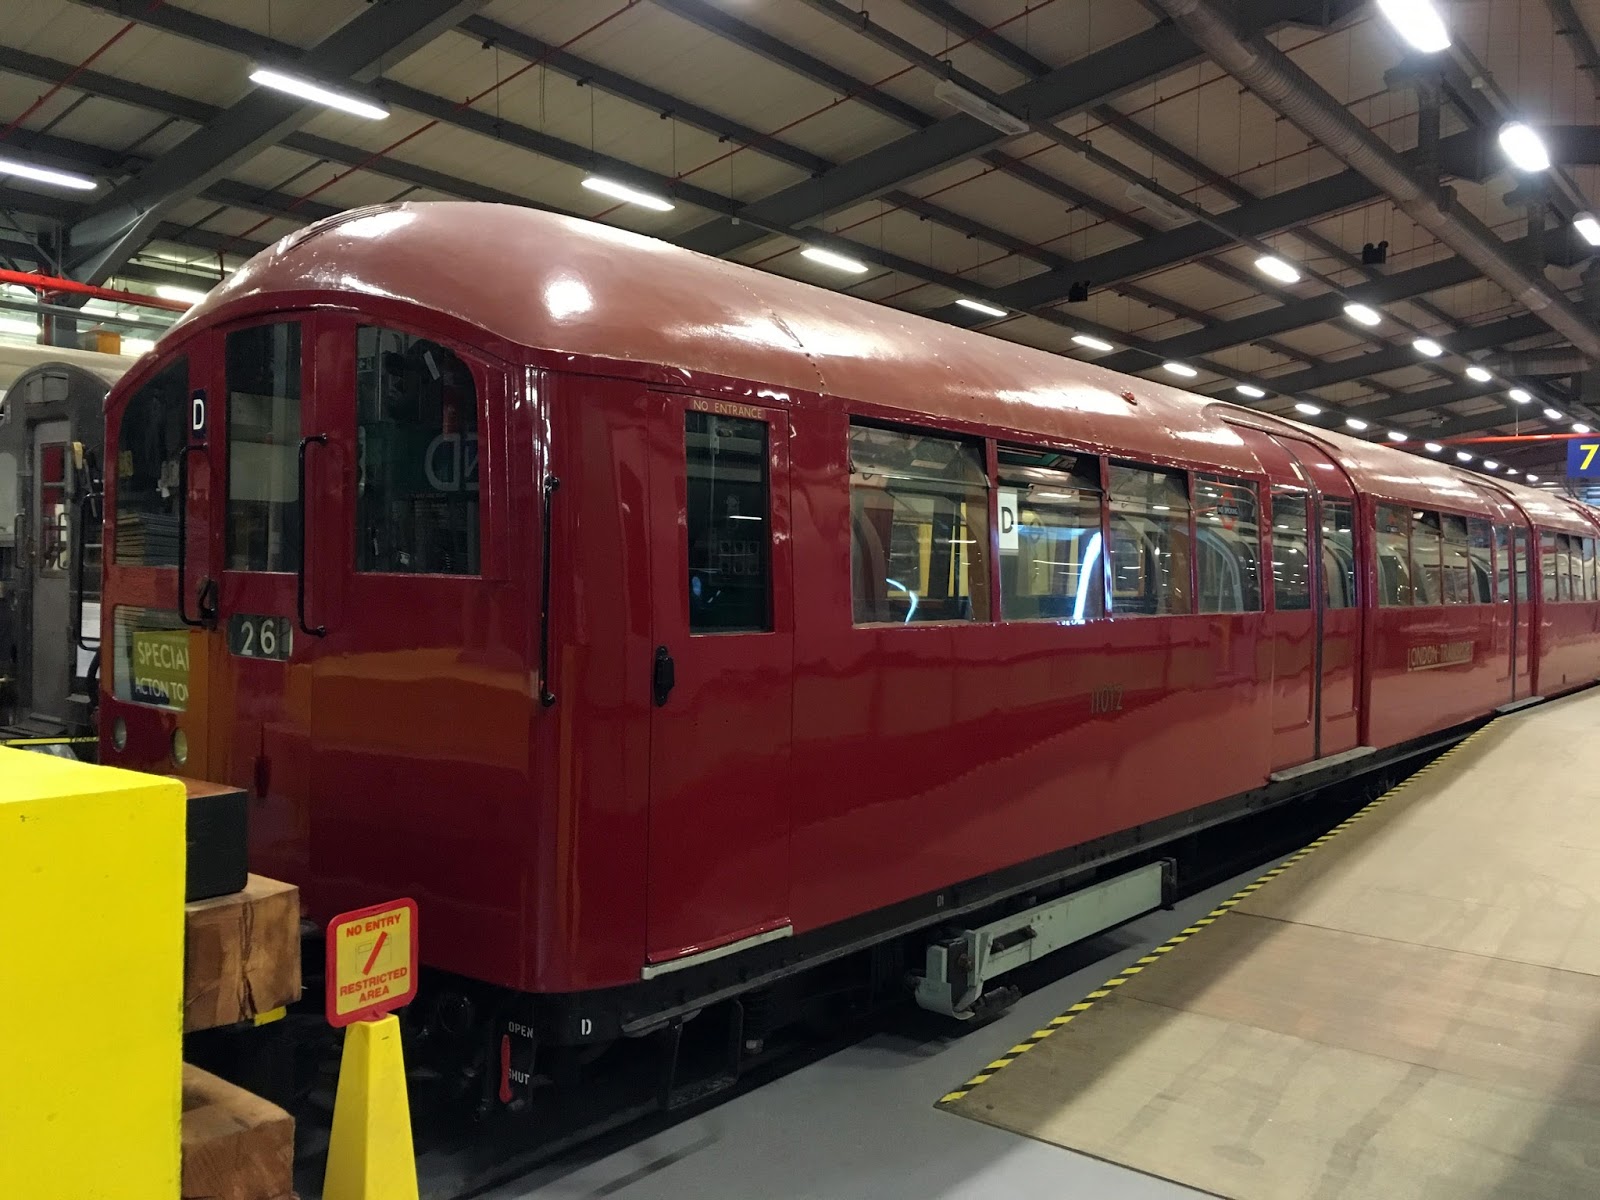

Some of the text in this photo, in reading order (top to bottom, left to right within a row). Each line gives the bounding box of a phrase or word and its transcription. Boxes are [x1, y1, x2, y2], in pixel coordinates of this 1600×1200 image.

[193, 398, 205, 430] D
[693, 400, 762, 419] NO ENTRANCE
[1580, 444, 1599, 470] 7
[1001, 506, 1014, 534] D
[240, 619, 275, 655] 26
[135, 676, 169, 699] ACTON
[346, 914, 401, 937] NO ENTRY
[340, 967, 408, 996] RESTRICTED
[359, 985, 390, 1003] AREA
[508, 1021, 534, 1038] OPEN
[581, 1018, 592, 1035] D
